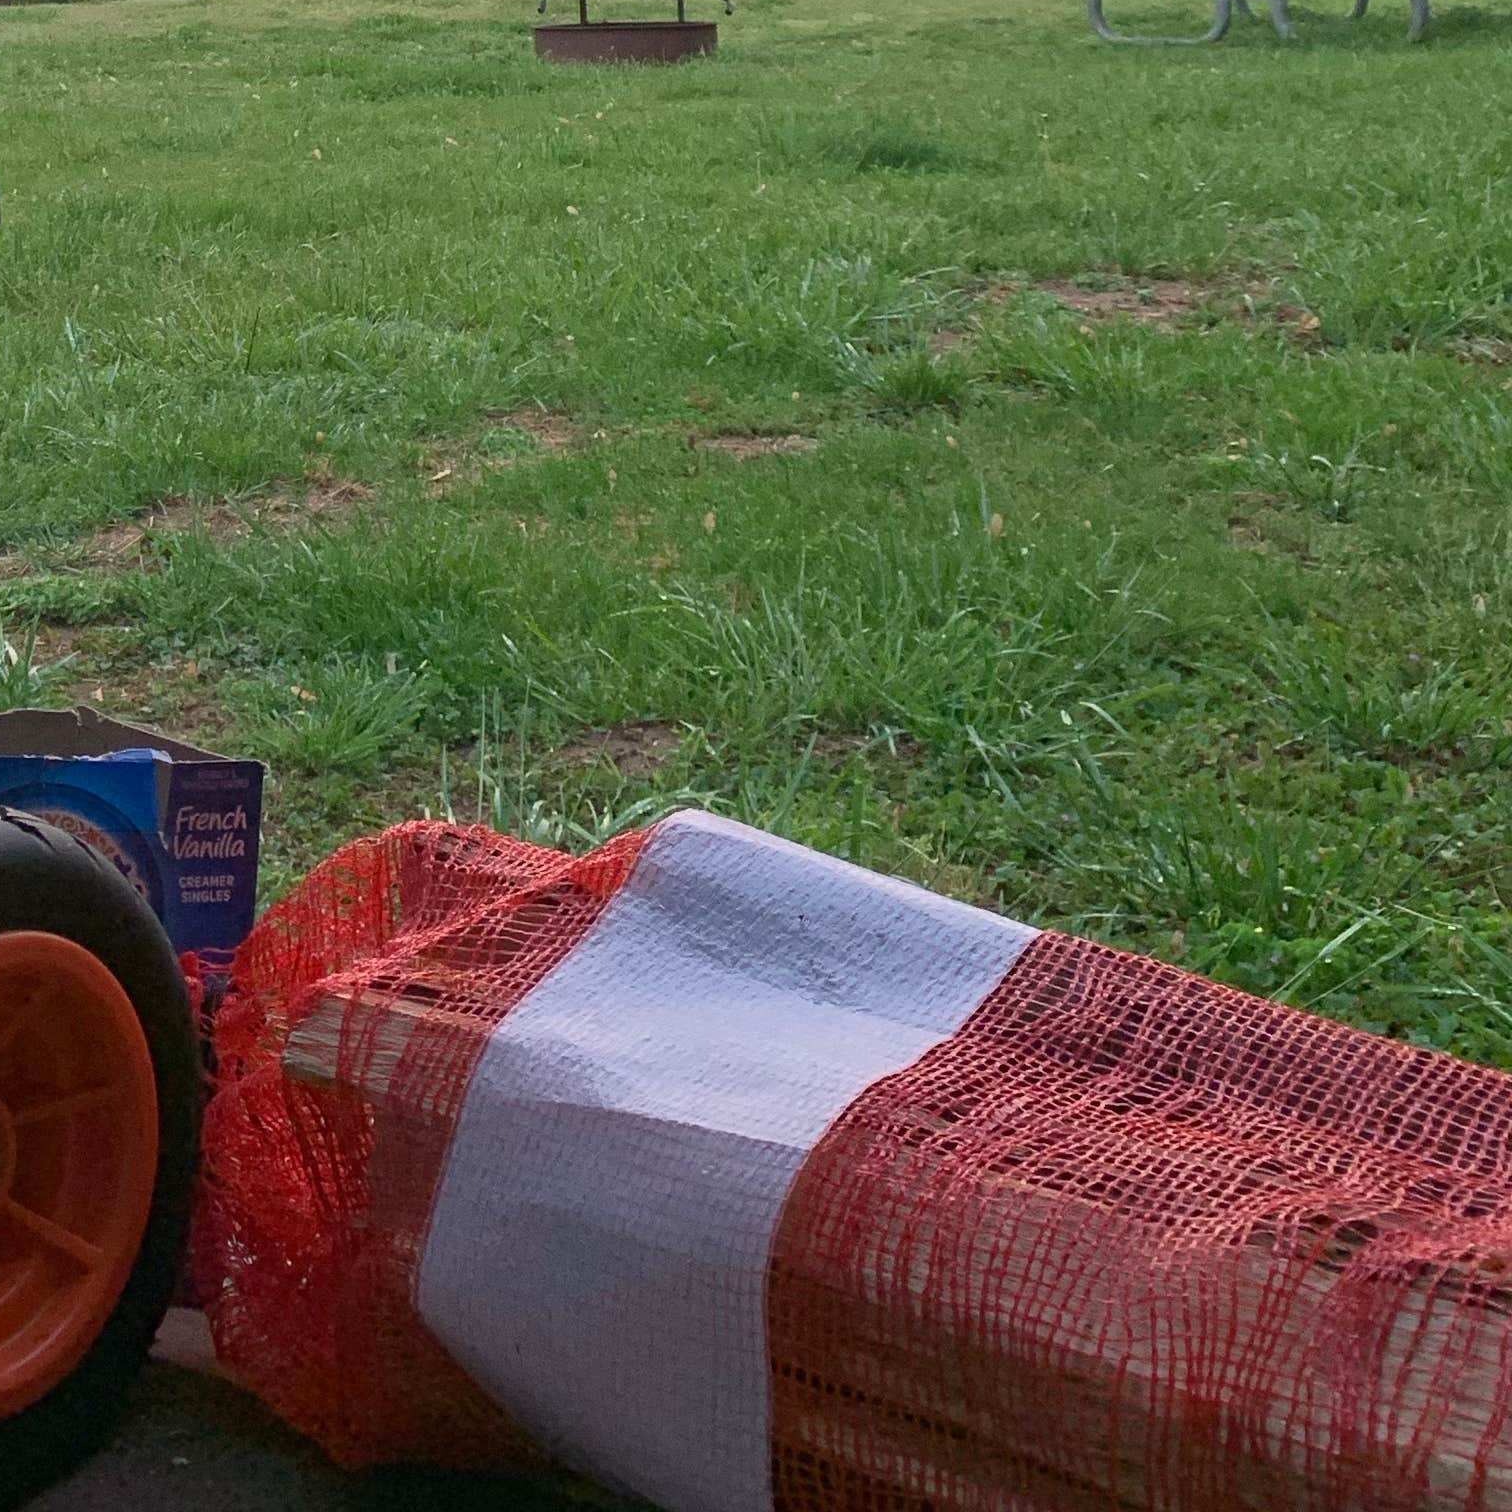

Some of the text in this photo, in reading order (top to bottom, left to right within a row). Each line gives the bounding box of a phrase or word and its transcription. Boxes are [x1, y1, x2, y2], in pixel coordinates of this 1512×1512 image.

[175, 805, 248, 832] French
[172, 831, 246, 860] Vanilla
[178, 874, 235, 889] CREAMER
[180, 889, 232, 903] SINGLES
